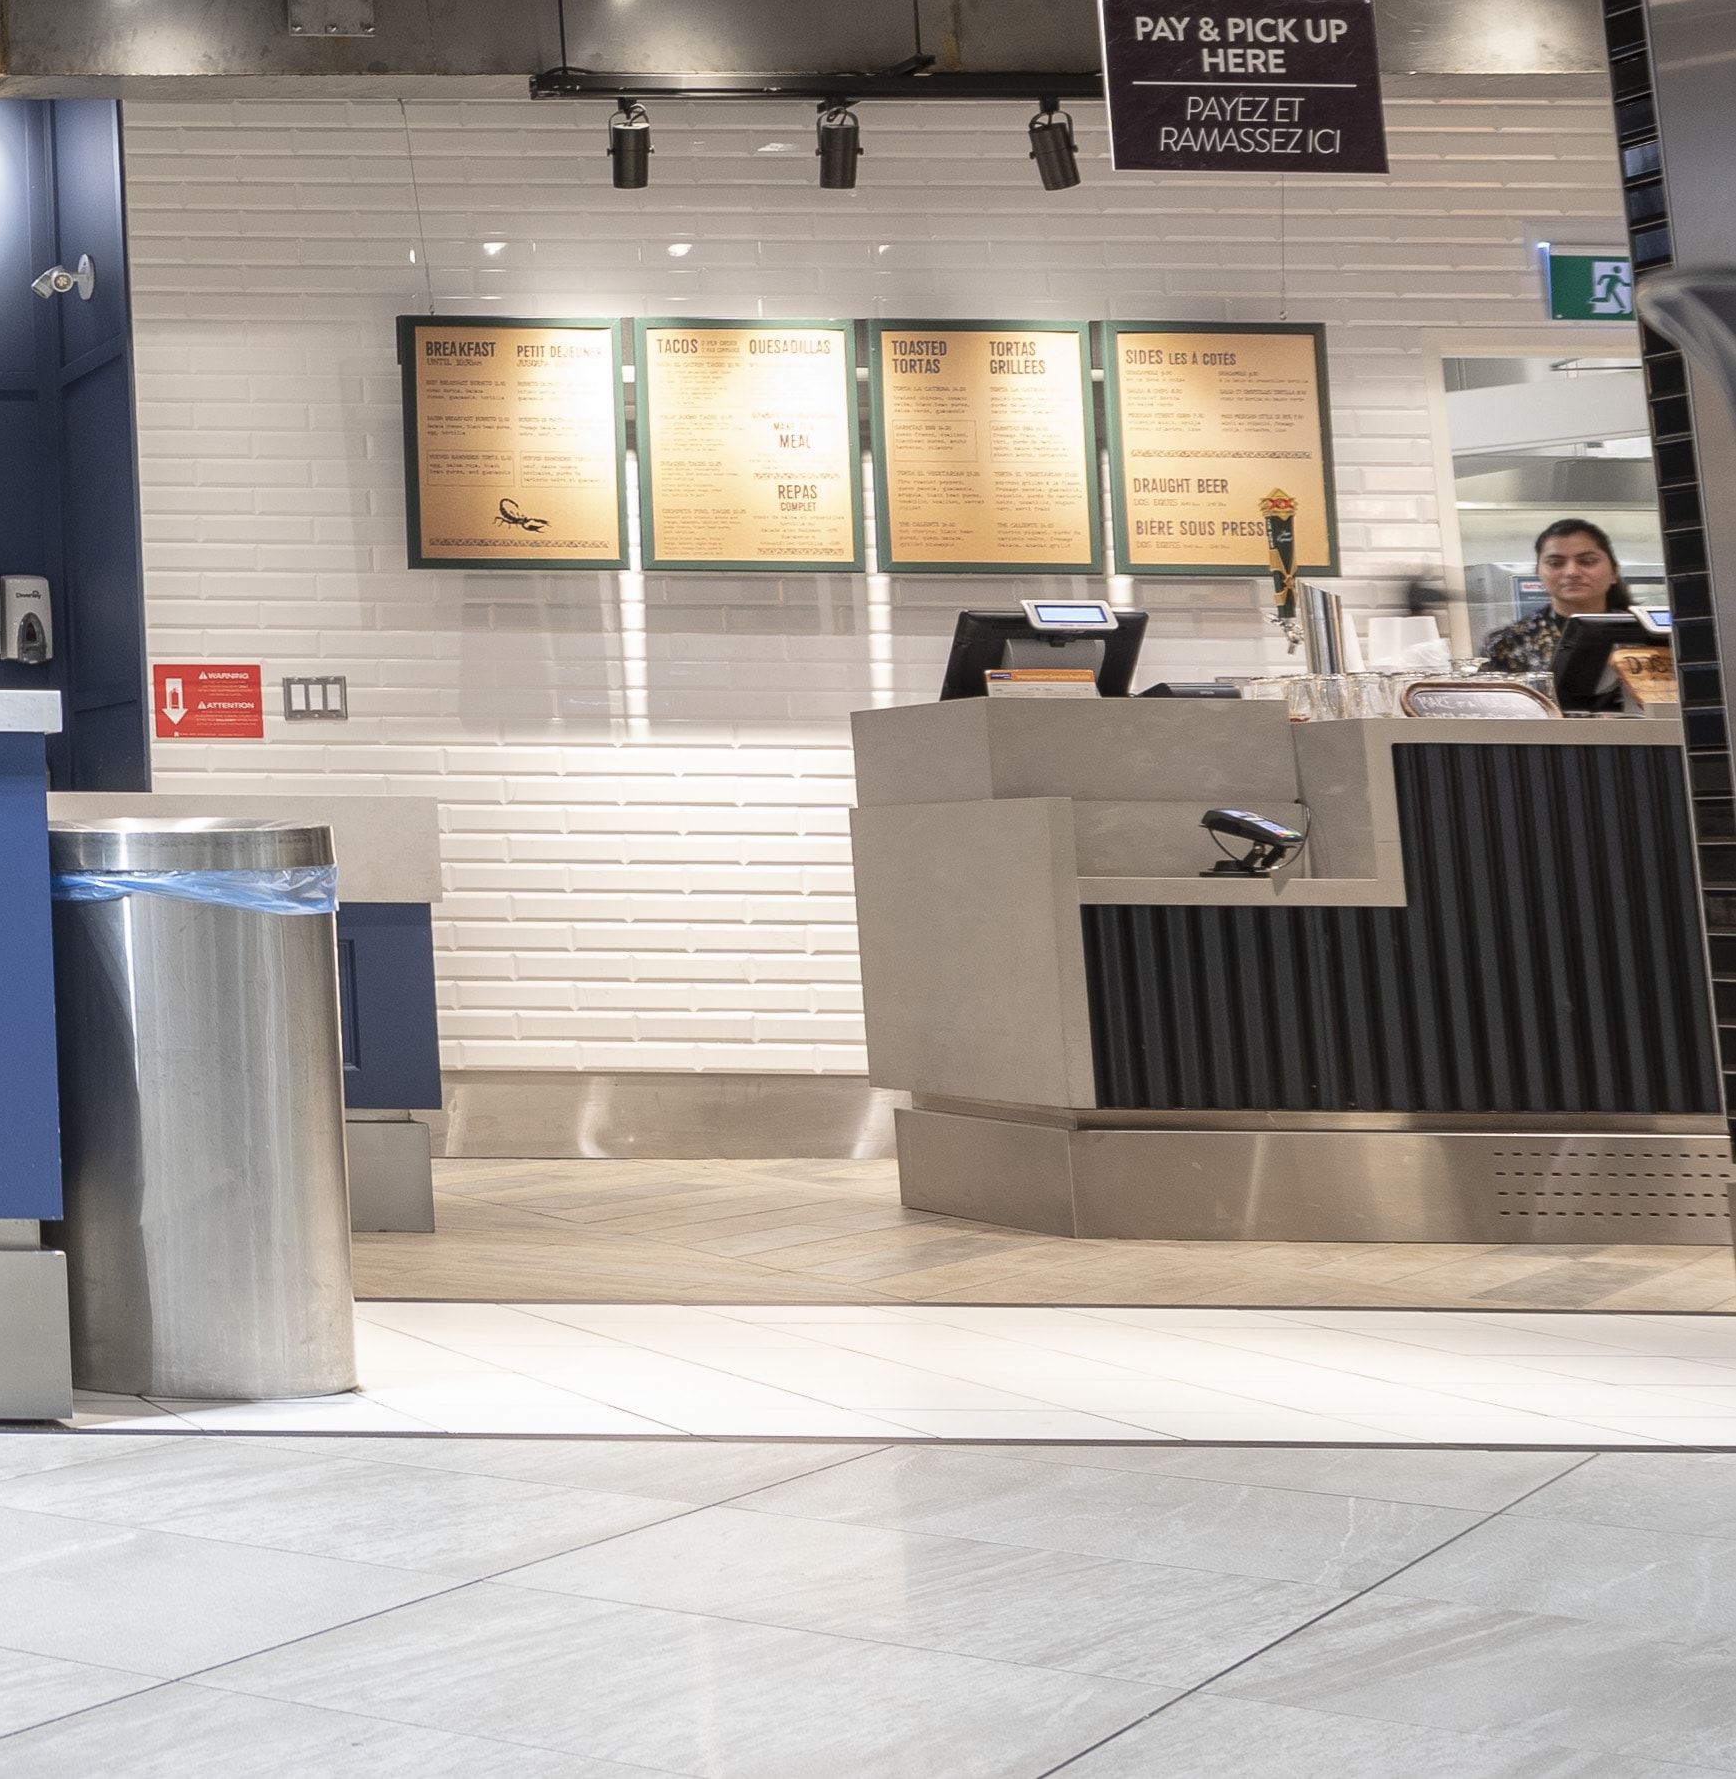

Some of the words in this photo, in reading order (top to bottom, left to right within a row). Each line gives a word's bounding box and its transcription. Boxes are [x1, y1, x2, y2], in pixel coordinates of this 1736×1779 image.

[1135, 17, 1190, 41] PAY
[1198, 17, 1221, 42] &
[1227, 18, 1300, 43] PICK
[1306, 19, 1348, 43] UP
[1202, 48, 1286, 73] HERE
[1187, 96, 1268, 122] PAYEZ
[1276, 98, 1305, 122] ET
[1160, 127, 1303, 153] RAMASSEZ
[1308, 129, 1341, 154] ICI
[426, 341, 496, 358] BREAKFAST
[517, 345, 545, 358] PETIT
[657, 339, 698, 354] TACOS
[749, 339, 831, 354] QUESADILLAS
[892, 340, 947, 356] TOASTED
[989, 341, 1036, 356] TORTAS
[1126, 349, 1163, 364] SIDES
[1169, 352, 1187, 365] LES
[892, 358, 941, 374] TORTAS
[779, 434, 812, 448] MEAL
[778, 484, 817, 499] REPAS
[1133, 478, 1191, 493] DRAUGHT
[1197, 479, 1229, 494] BEER
[780, 502, 816, 512] COMPLET
[1136, 518, 1174, 535] BIÈRE
[1180, 520, 1215, 536] SOUS
[1222, 521, 1265, 537] PRESS
